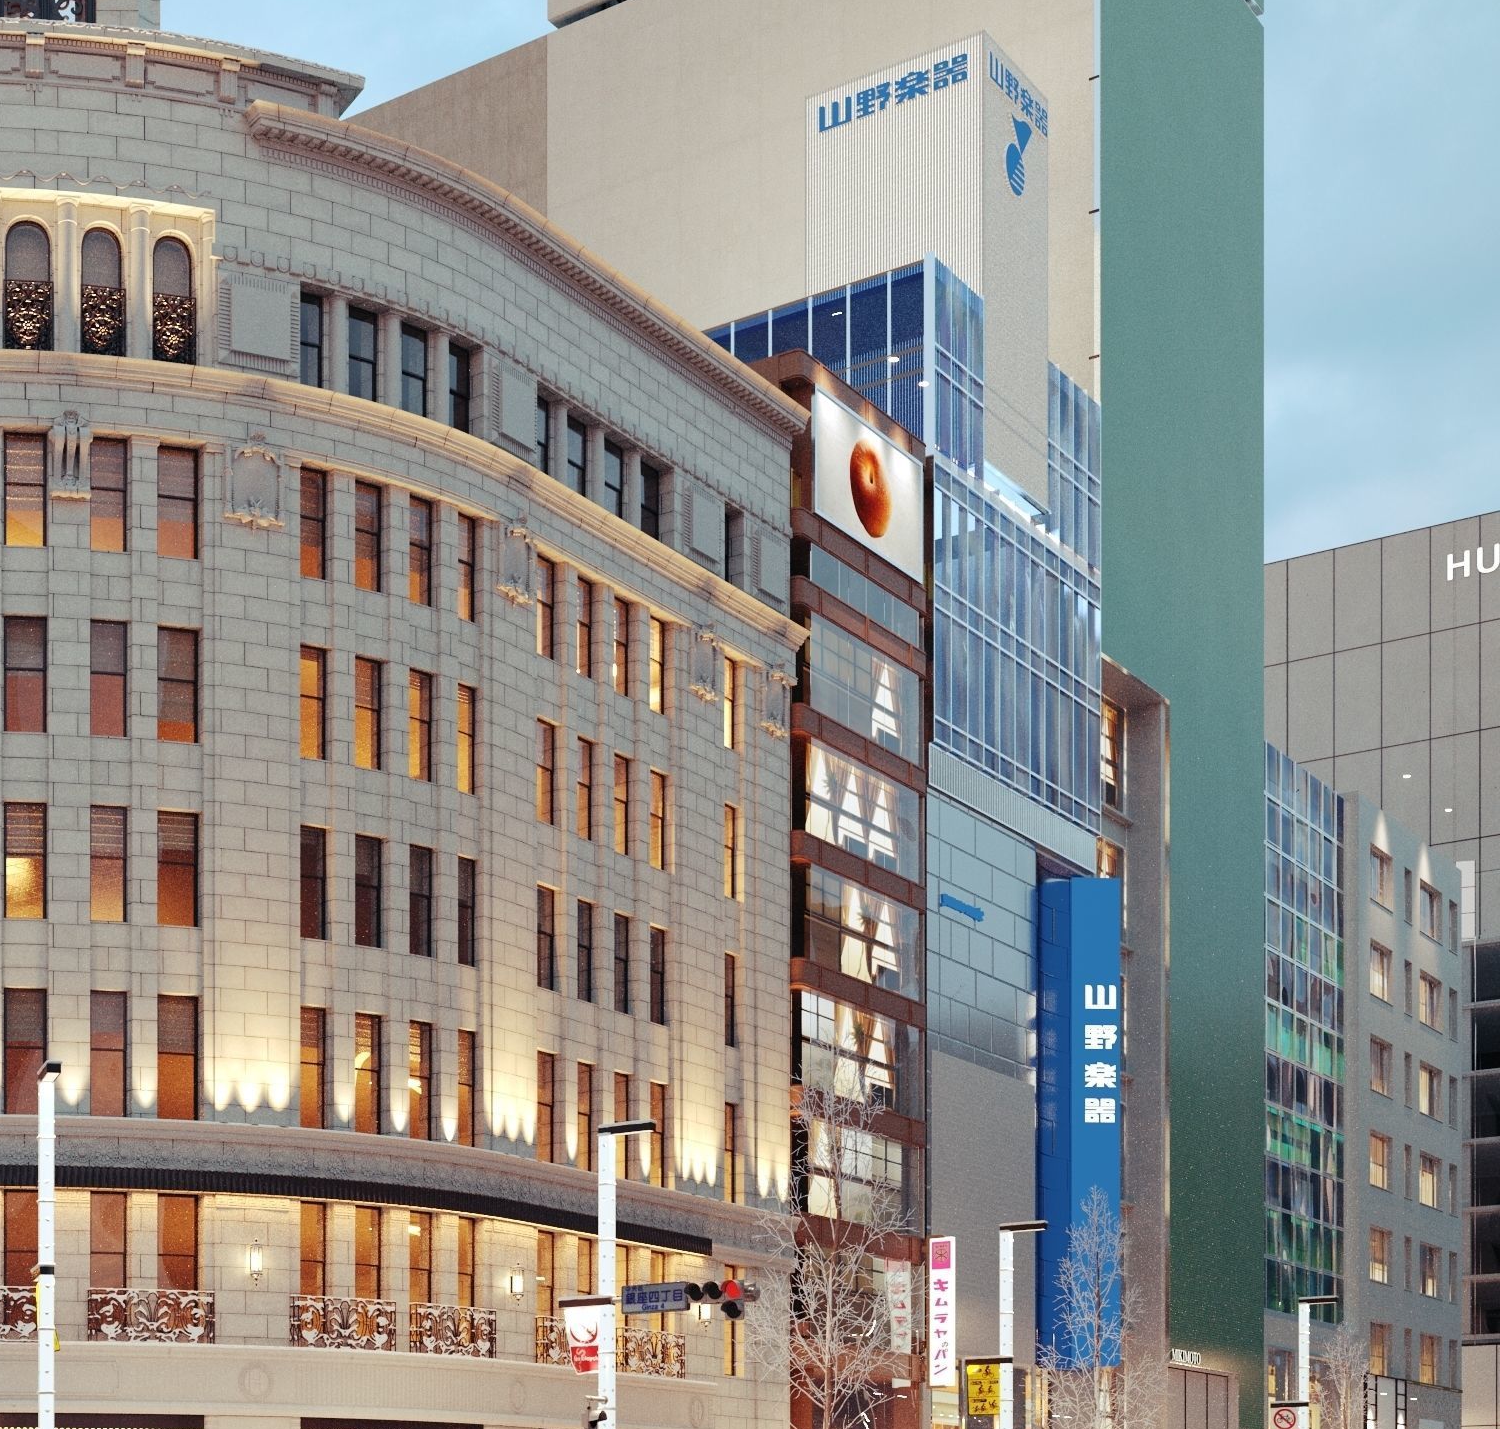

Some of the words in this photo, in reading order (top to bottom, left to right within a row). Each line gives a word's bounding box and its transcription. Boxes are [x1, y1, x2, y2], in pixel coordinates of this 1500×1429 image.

[818, 53, 969, 133] 山野楽器
[989, 50, 1048, 138] 山野楽器
[1084, 984, 1118, 1124] 山野楽器
[933, 1278, 949, 1375] キムラヤのパン
